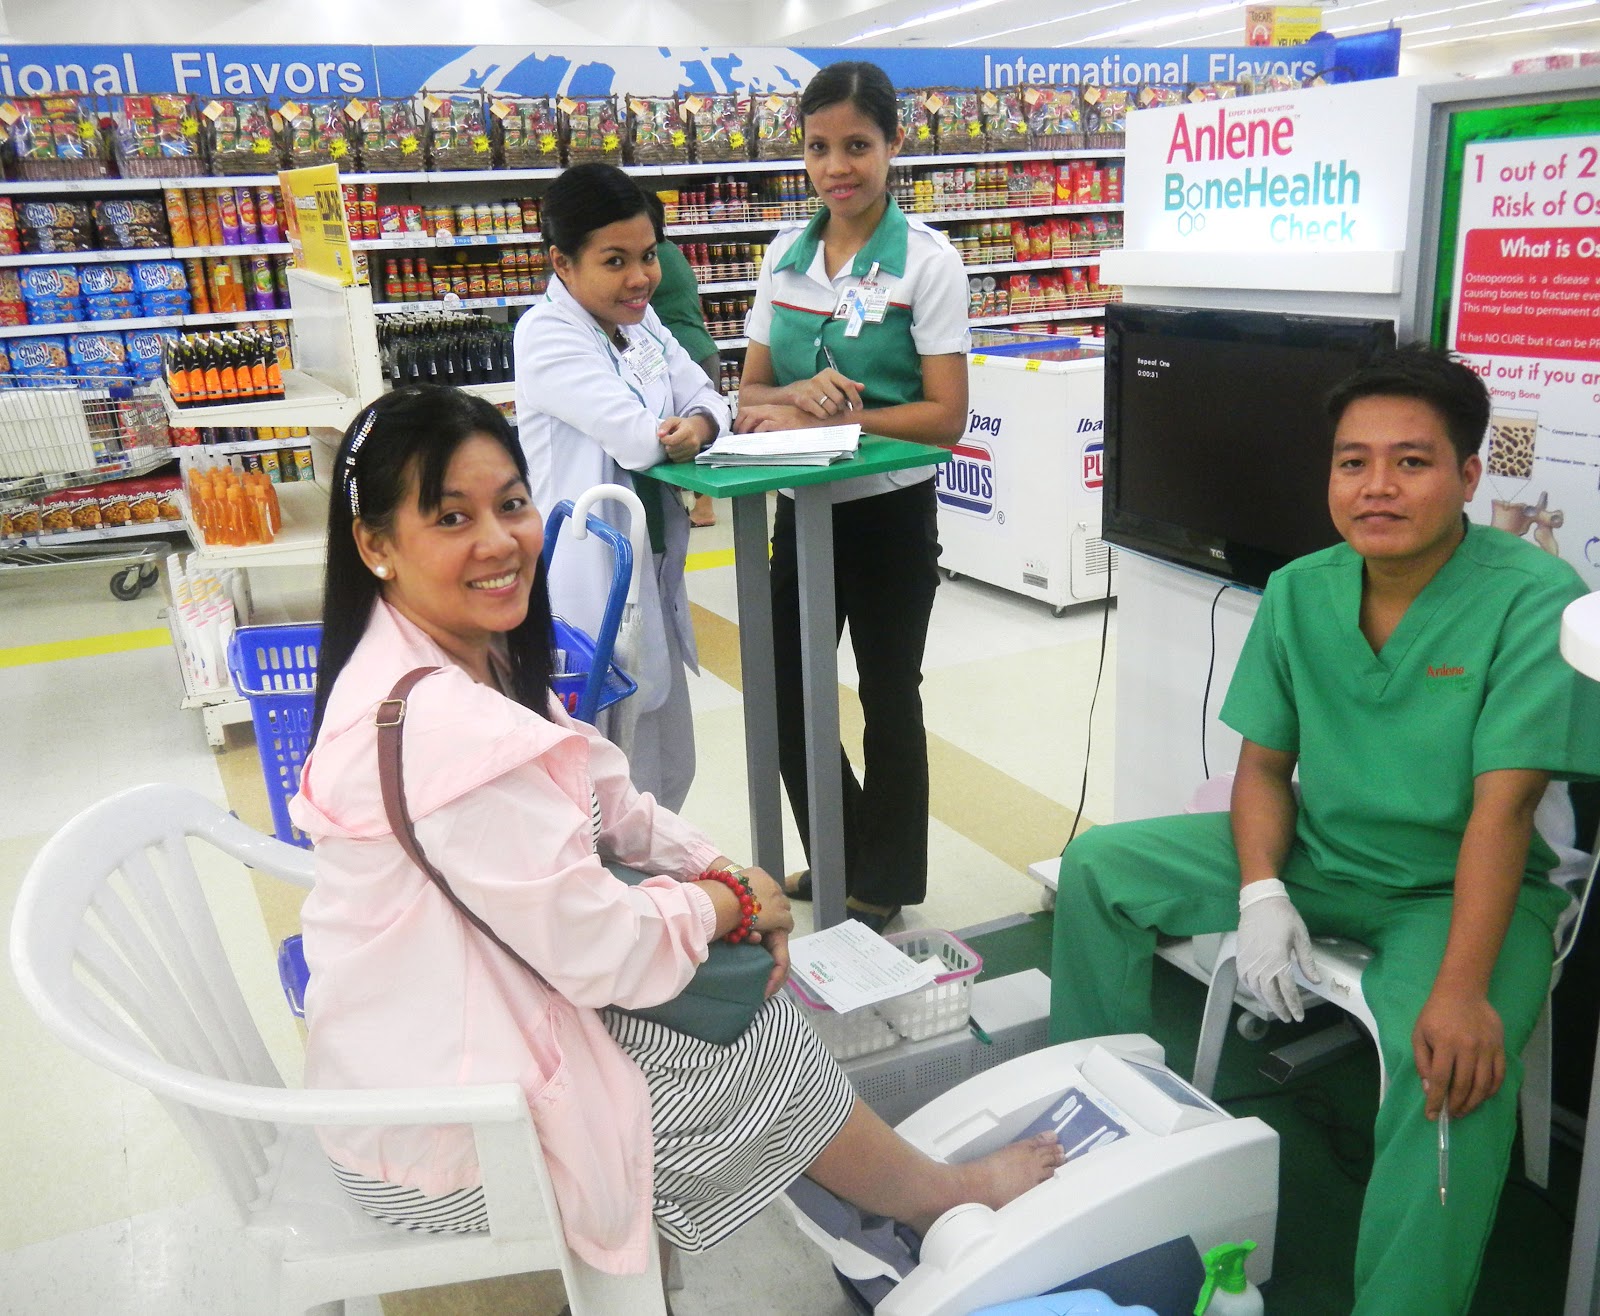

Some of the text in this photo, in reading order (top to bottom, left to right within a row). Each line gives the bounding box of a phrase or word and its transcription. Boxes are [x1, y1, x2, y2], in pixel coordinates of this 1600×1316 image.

[172, 52, 365, 94] Flavors
[984, 54, 1316, 88] International Flavors
[1166, 108, 1294, 164] Anlene
[1475, 146, 1598, 183] 1 out of 2
[1165, 160, 1360, 210] BoneHealth
[1492, 191, 1535, 217] Risk
[1543, 190, 1567, 216] of
[1270, 212, 1356, 243] Check
[1500, 236, 1551, 258] What
[1556, 238, 1571, 258] is
[29, 271, 54, 287] Chips
[1465, 272, 1524, 285] Osteoporosis
[1529, 274, 1536, 284] is
[1541, 276, 1548, 284] a
[1553, 274, 1590, 285] disease
[1464, 288, 1498, 301] causing
[1500, 288, 1528, 300] bones
[1530, 290, 1540, 299] to
[1543, 289, 1580, 300] fracture
[1463, 302, 1480, 313] This
[1482, 305, 1501, 316] may
[1503, 303, 1523, 314] lead
[1524, 305, 1534, 315] to
[1536, 306, 1590, 317] permanent
[1460, 332, 1466, 341] It
[1468, 333, 1483, 343] has
[1484, 333, 1499, 344] NO
[1501, 333, 1525, 345] CURE
[1527, 336, 1544, 346] but
[1546, 337, 1553, 346] it
[1554, 339, 1572, 347] can
[1574, 337, 1587, 348] be
[18, 344, 43, 360] Chips
[1137, 358, 1157, 366] Repeat
[1497, 364, 1523, 379] out
[1528, 362, 1540, 380] if
[1544, 369, 1576, 387] you
[1490, 386, 1541, 400] Strong Bone
[936, 459, 993, 499] FOODS
[1210, 548, 1225, 559] TCL
